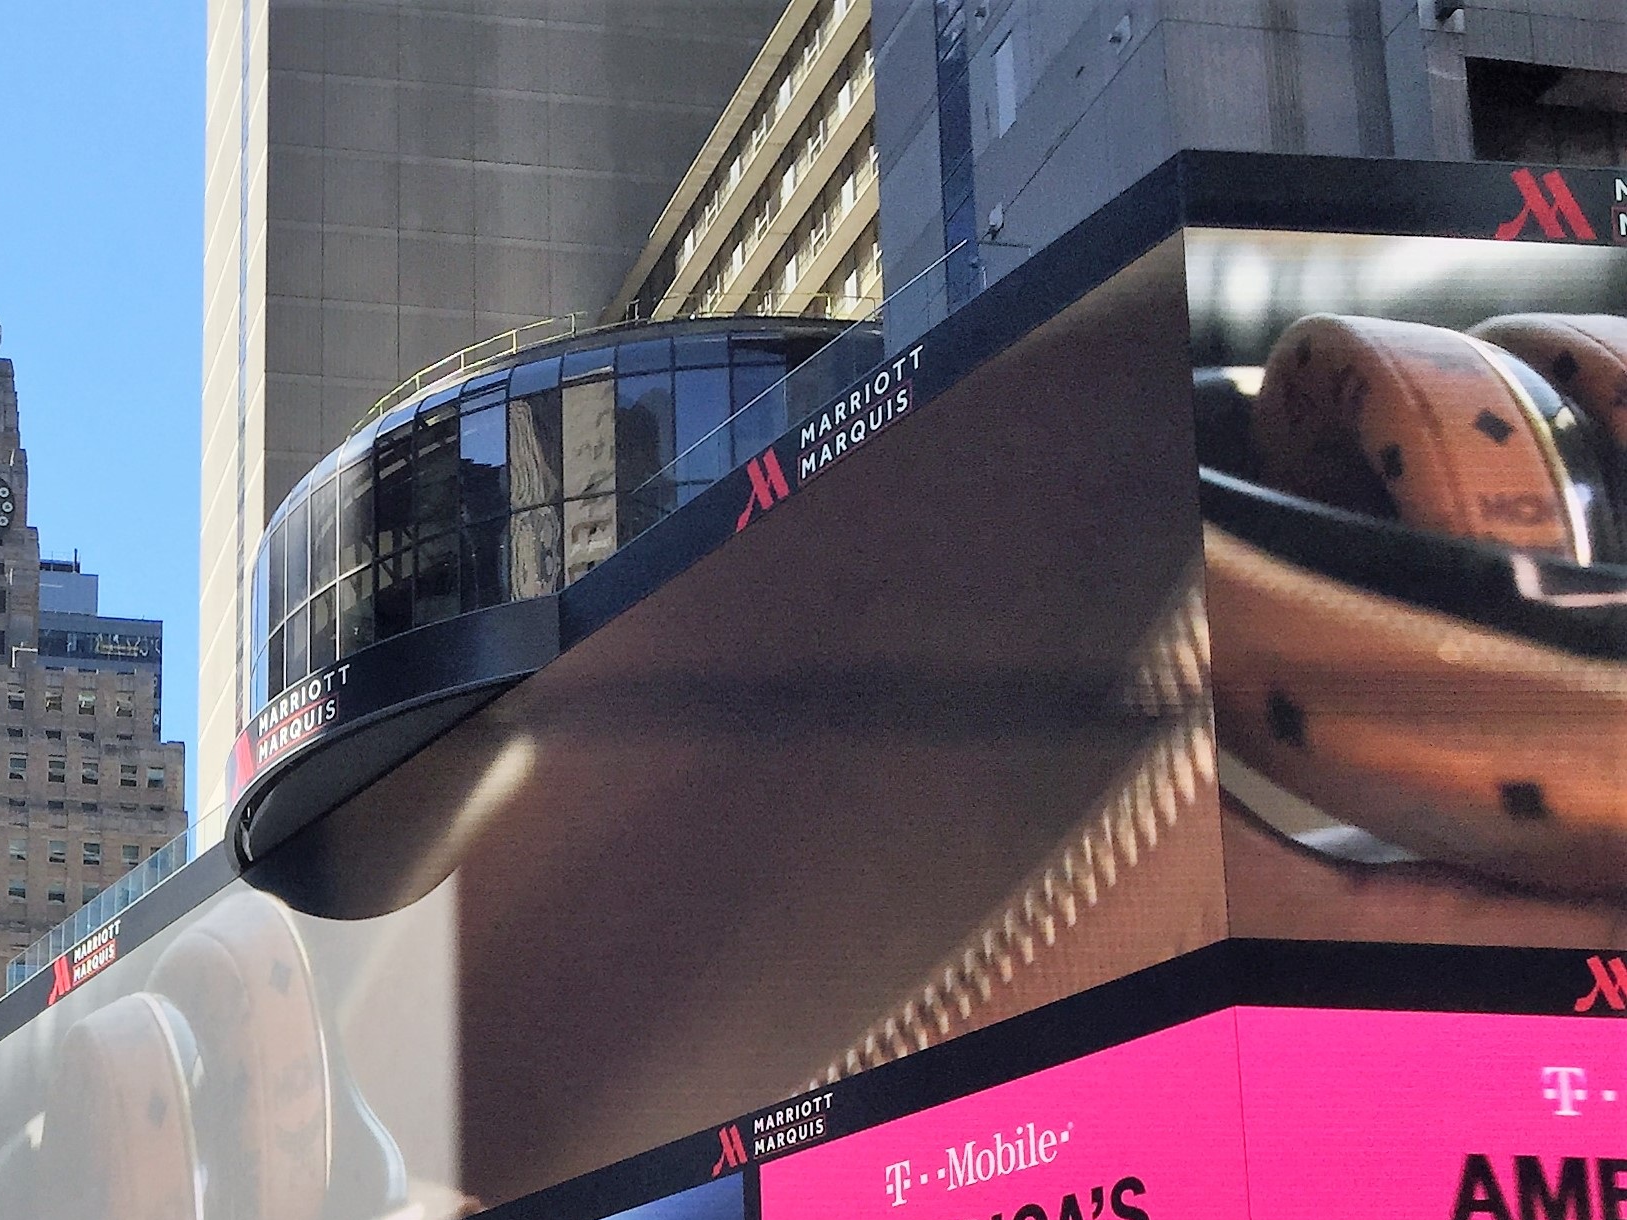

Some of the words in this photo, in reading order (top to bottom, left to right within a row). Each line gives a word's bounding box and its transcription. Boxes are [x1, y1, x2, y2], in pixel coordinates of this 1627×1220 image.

[800, 345, 923, 449] MARRIOTT
[800, 388, 909, 480] MARQUIS
[258, 664, 351, 736] MARRIOTT
[258, 699, 336, 764] MARQUIS
[73, 919, 121, 963] MARRIOTT
[73, 943, 115, 982] MARQUIS
[753, 1093, 834, 1131] MARRIOTT
[754, 1119, 825, 1155] MARQUIS
